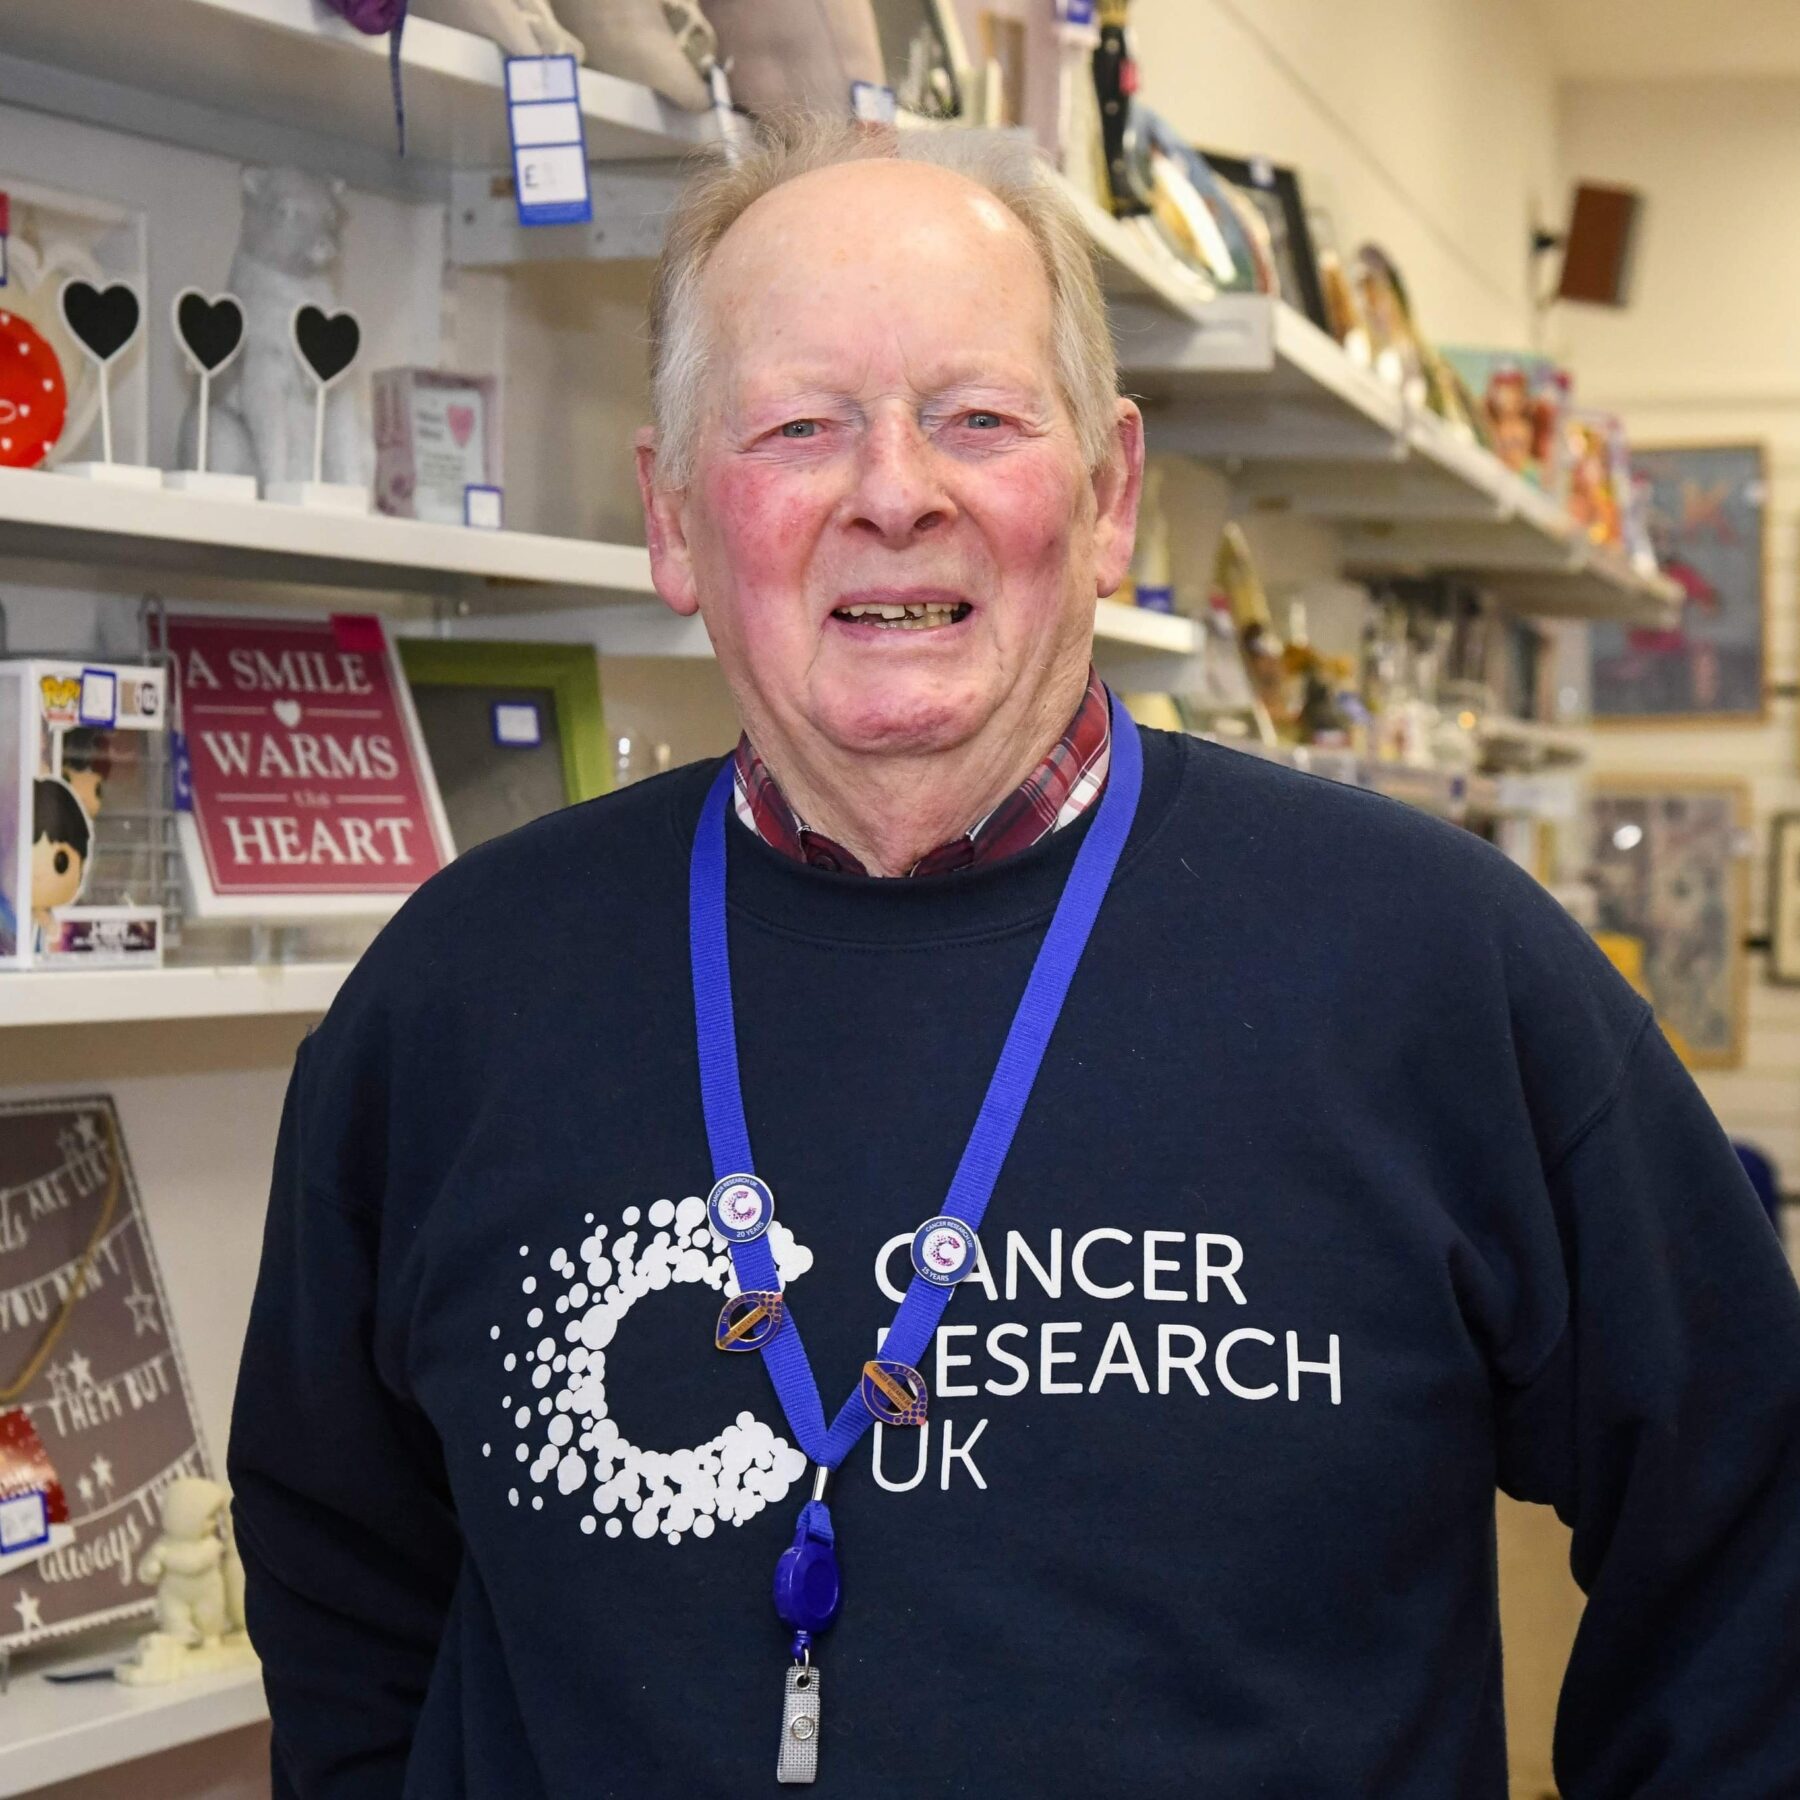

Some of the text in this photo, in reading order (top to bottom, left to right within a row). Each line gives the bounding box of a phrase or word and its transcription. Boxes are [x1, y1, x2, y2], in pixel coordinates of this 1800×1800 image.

[186, 648, 374, 695] A SMILE
[201, 731, 399, 780] WARMS
[223, 815, 414, 866] HEART
[745, 1221, 765, 1236] YEARS
[929, 1271, 951, 1282] YEARS
[123, 1357, 171, 1411] BUT
[877, 1322, 1342, 1405] ESEARCH
[872, 1418, 989, 1492] UK
[38, 1512, 143, 1588] always
